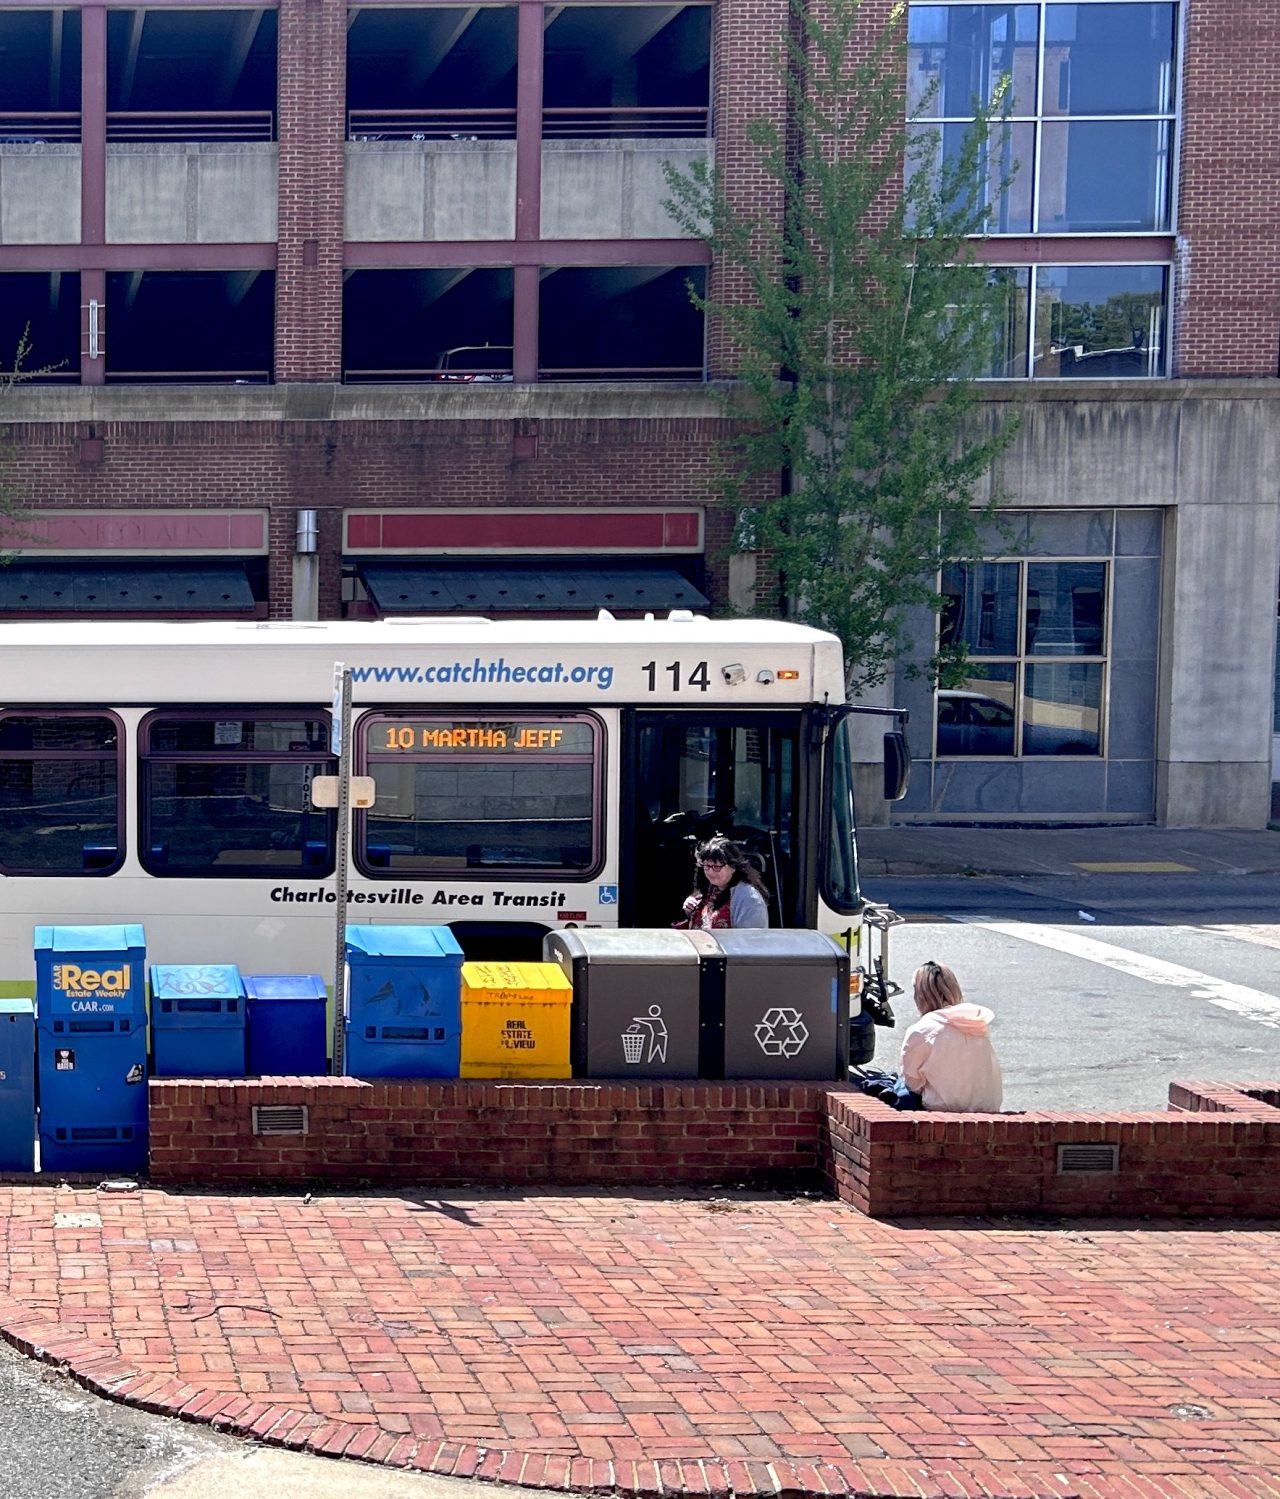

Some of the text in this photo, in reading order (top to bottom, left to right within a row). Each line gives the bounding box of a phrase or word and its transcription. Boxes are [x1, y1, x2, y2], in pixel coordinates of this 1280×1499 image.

[350, 658, 614, 690] www.catchthecat.org
[641, 660, 711, 692] 114
[386, 728, 563, 748] 10 MARTHA JEFF
[270, 887, 566, 907] Charlotesville Area Transit
[53, 965, 62, 990] CAAR
[61, 965, 131, 990] Real
[66, 990, 126, 999] Estate Weekly
[506, 1020, 527, 1029] REAL
